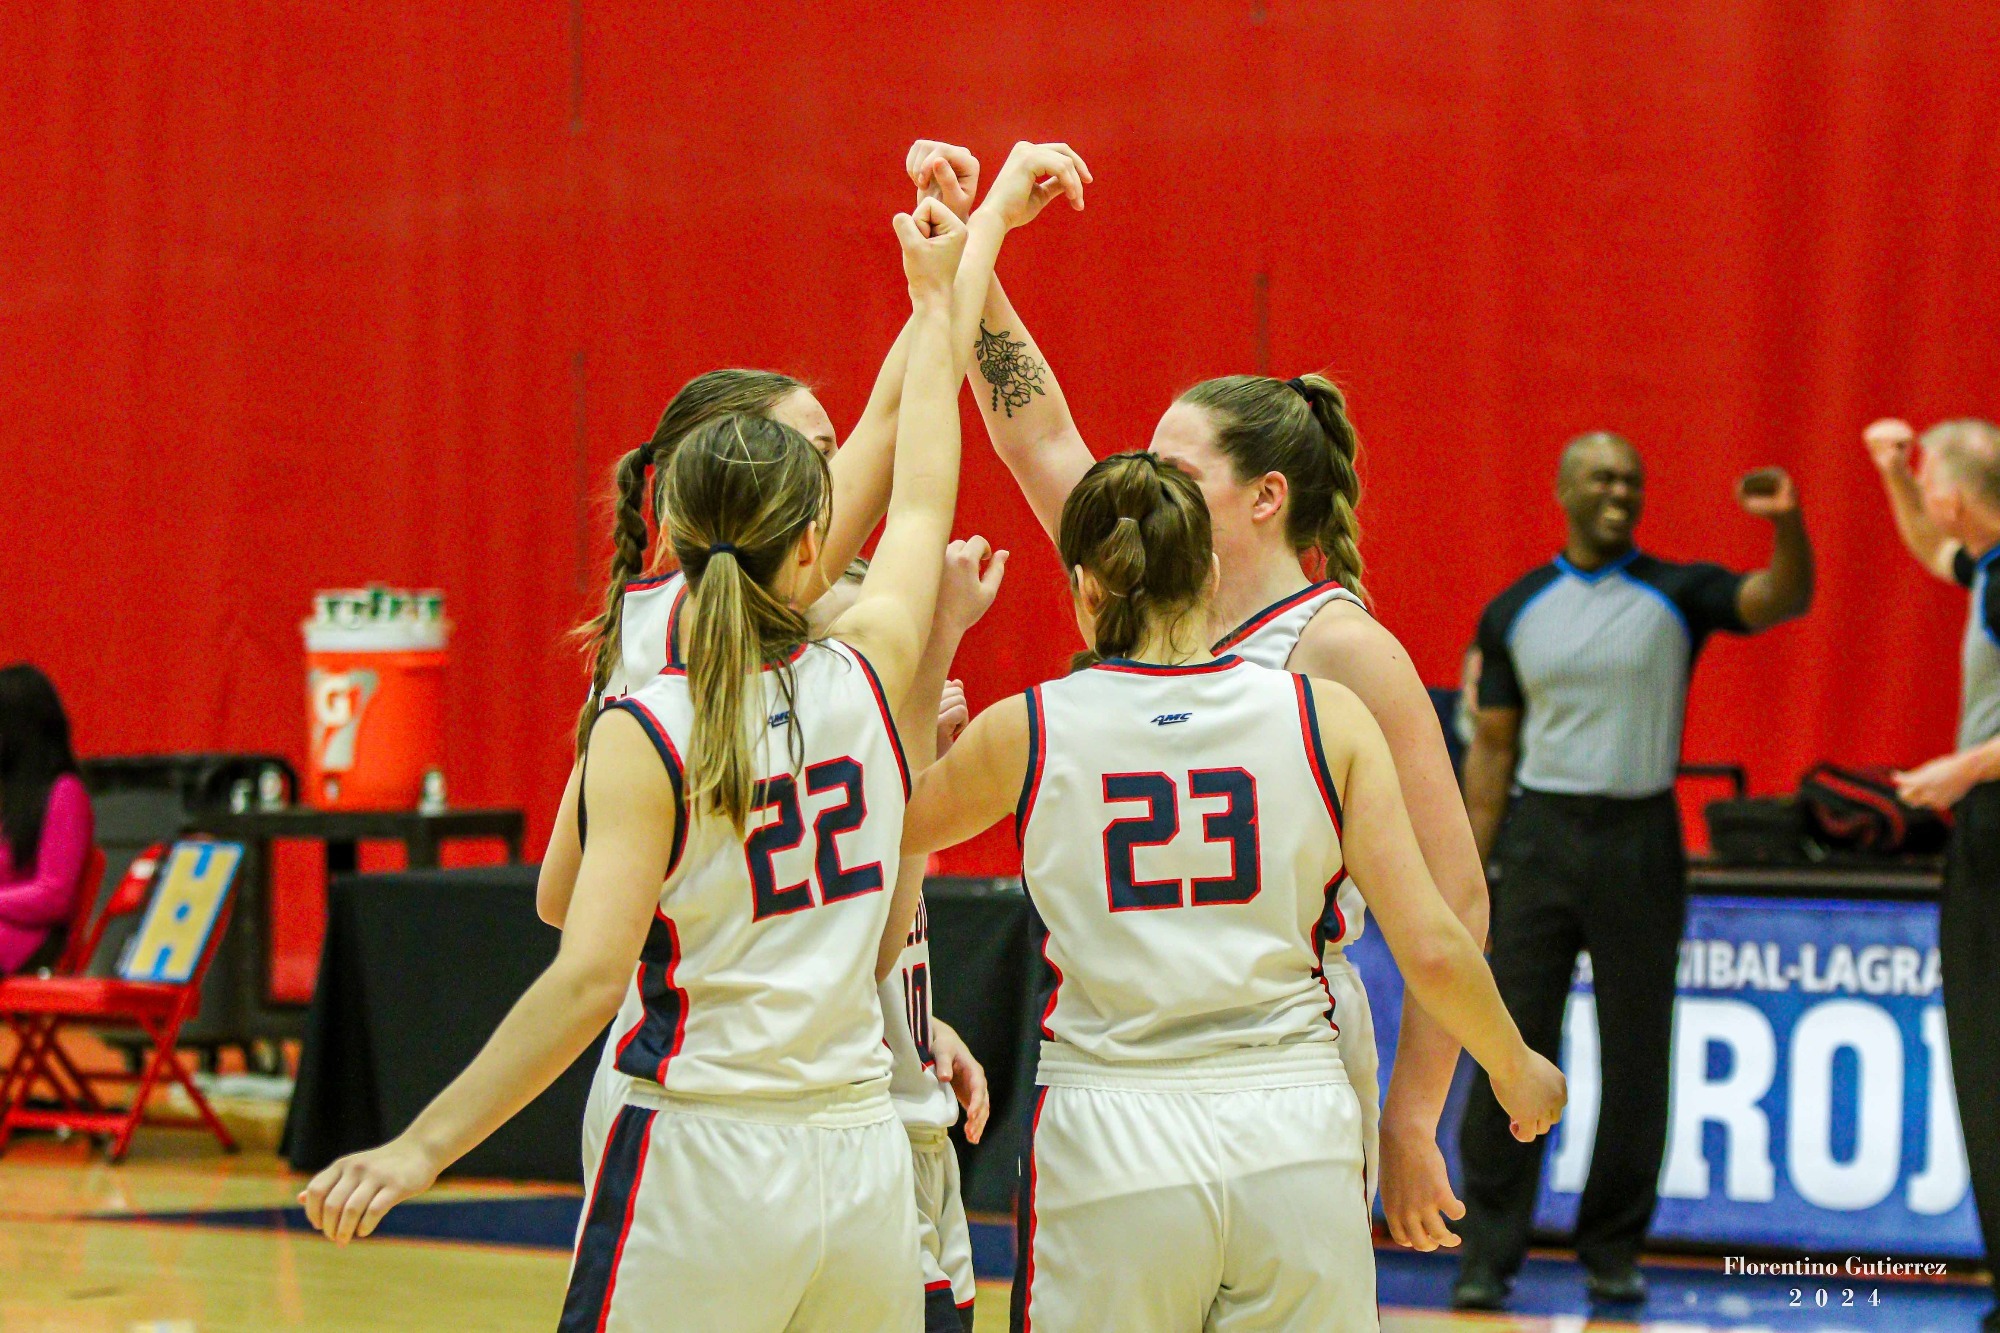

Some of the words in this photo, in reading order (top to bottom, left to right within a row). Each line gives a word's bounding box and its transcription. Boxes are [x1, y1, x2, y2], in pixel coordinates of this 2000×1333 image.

[1150, 712, 1193, 726] AMC
[744, 755, 884, 923] 22
[1102, 766, 1262, 913] 23
